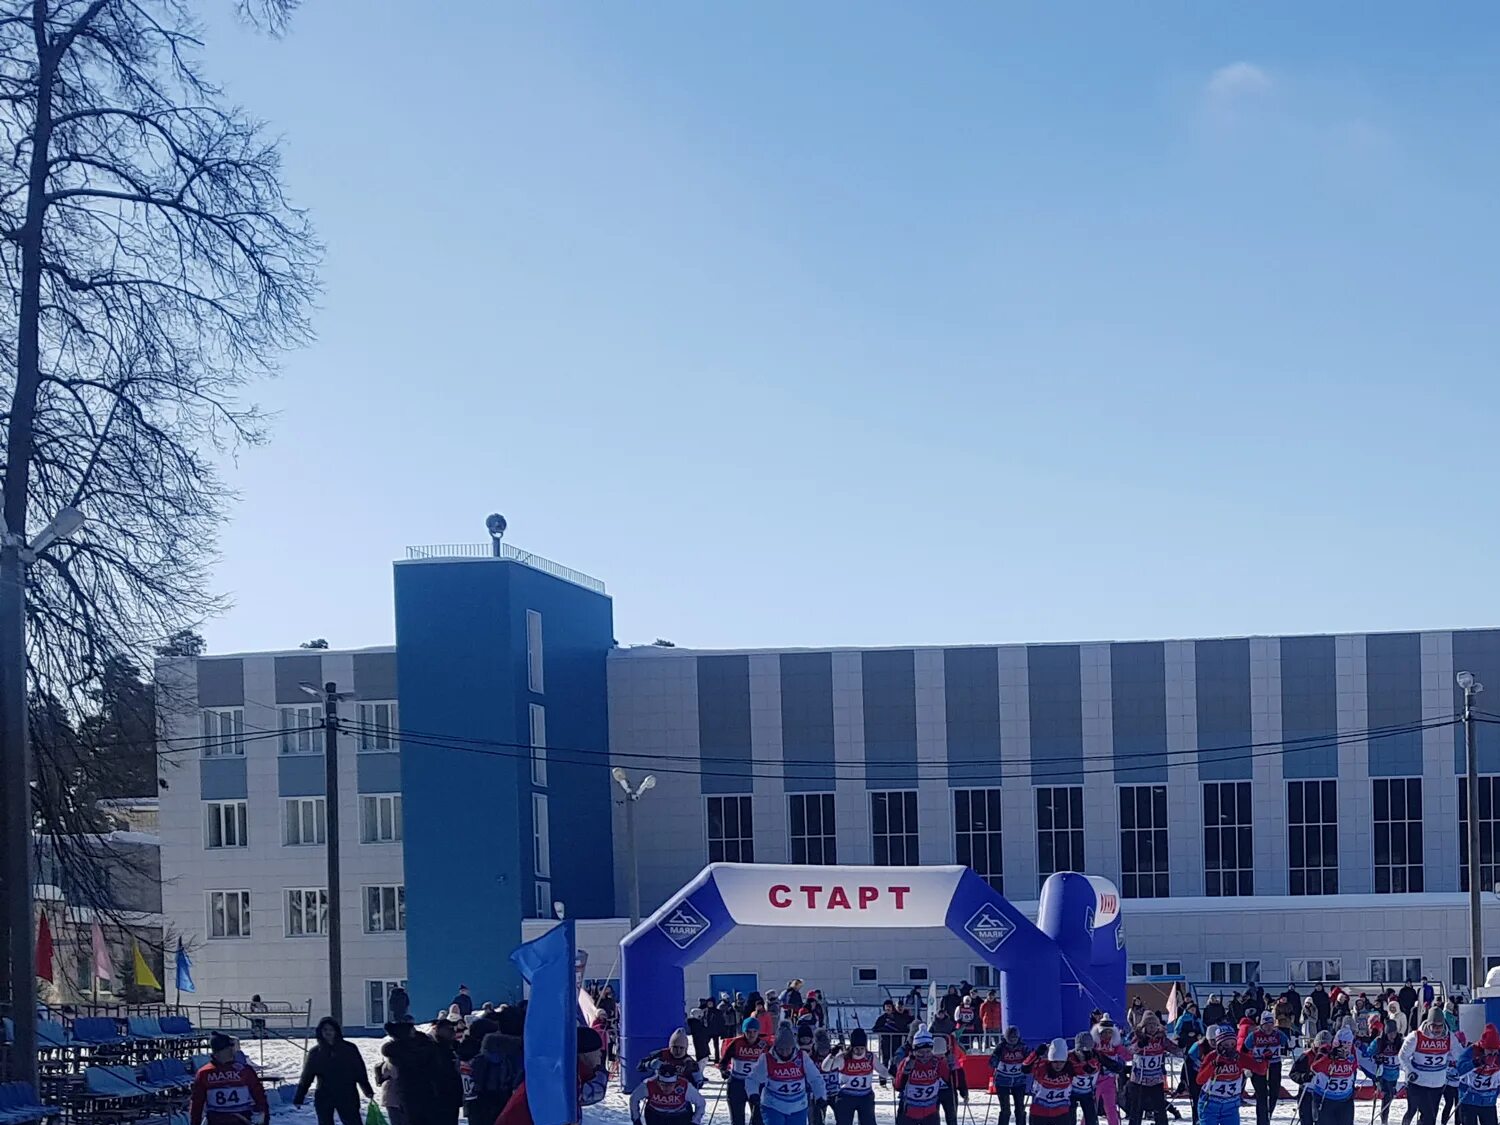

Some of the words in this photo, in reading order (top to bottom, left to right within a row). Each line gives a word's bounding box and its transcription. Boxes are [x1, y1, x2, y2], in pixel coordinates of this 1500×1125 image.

[768, 884, 911, 910] СТАРТ
[669, 926, 697, 935] МАЯК
[978, 930, 1004, 938] МАЯК
[1420, 1040, 1447, 1049] МАЯК
[738, 1046, 765, 1055] МАЯК
[1256, 1048, 1279, 1057] 14
[1424, 1056, 1444, 1066] 32
[848, 1062, 872, 1071] МАЯК
[1328, 1064, 1353, 1073] МАЯК
[207, 1071, 241, 1081] МАЯК
[774, 1067, 801, 1077] МАЯК
[911, 1069, 938, 1079] МАЯК
[850, 1076, 867, 1088] 61
[1328, 1079, 1348, 1091] 55
[777, 1082, 802, 1093] 42
[913, 1086, 935, 1098] 39
[215, 1090, 240, 1105] 84
[652, 1093, 681, 1104] МАЯК
[1045, 1090, 1066, 1100] 44
